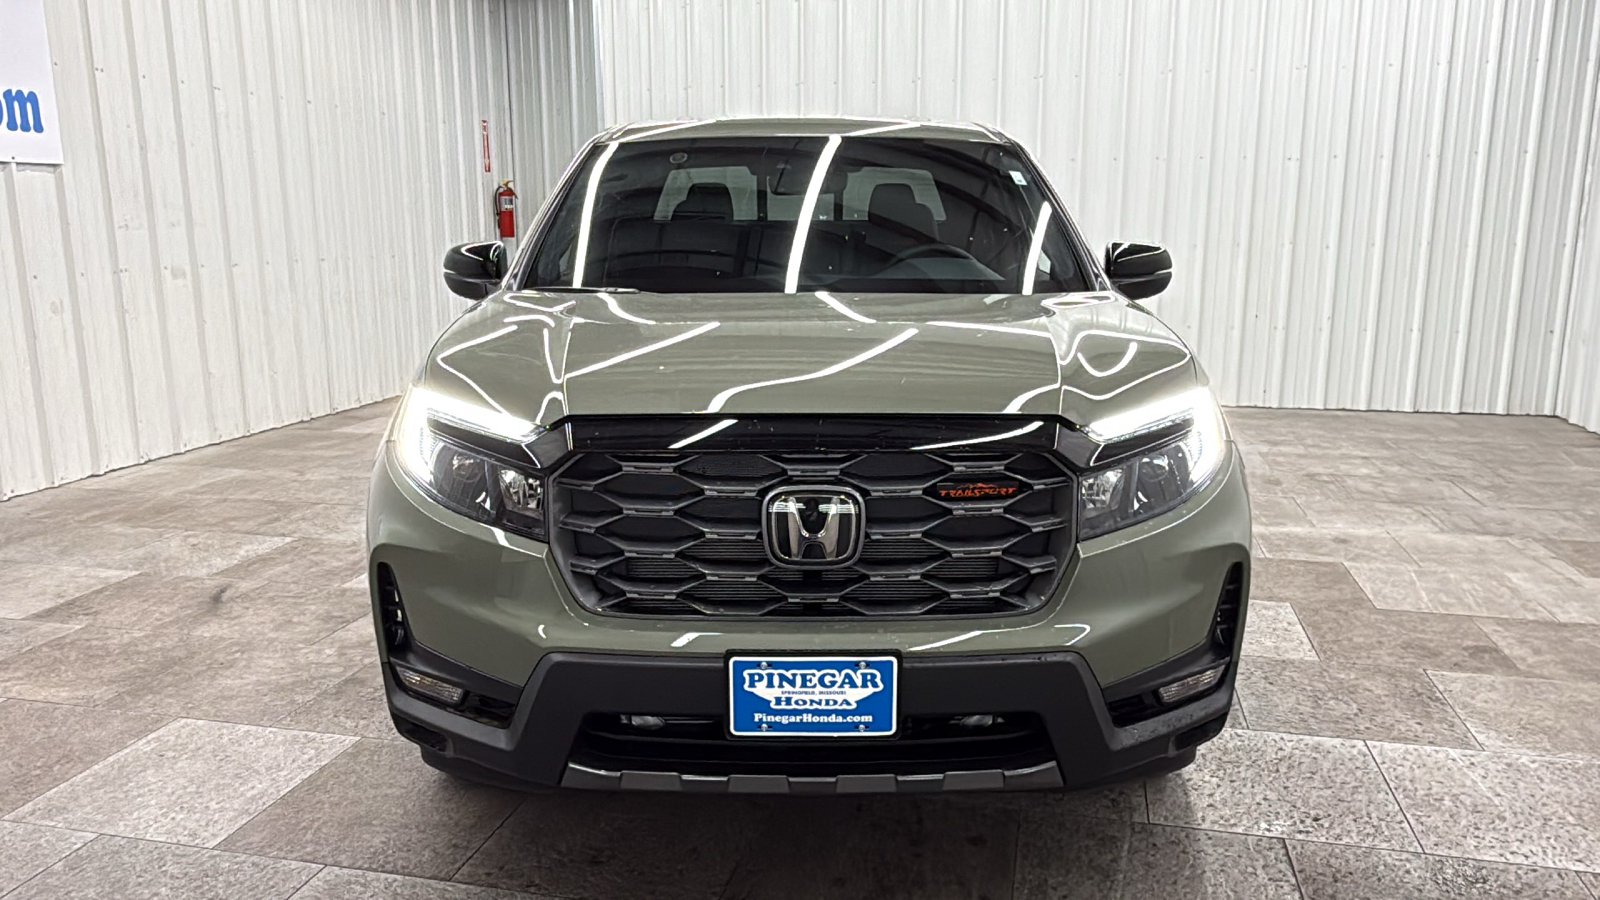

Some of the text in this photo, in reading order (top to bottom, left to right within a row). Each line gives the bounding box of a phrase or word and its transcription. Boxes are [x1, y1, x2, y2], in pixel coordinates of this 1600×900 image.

[0, 89, 44, 133] m
[939, 487, 1017, 497] TRAILSPORT
[747, 672, 880, 689] PINEGAR
[774, 696, 853, 707] HONDA
[753, 713, 873, 724] PinegarHonda.com
